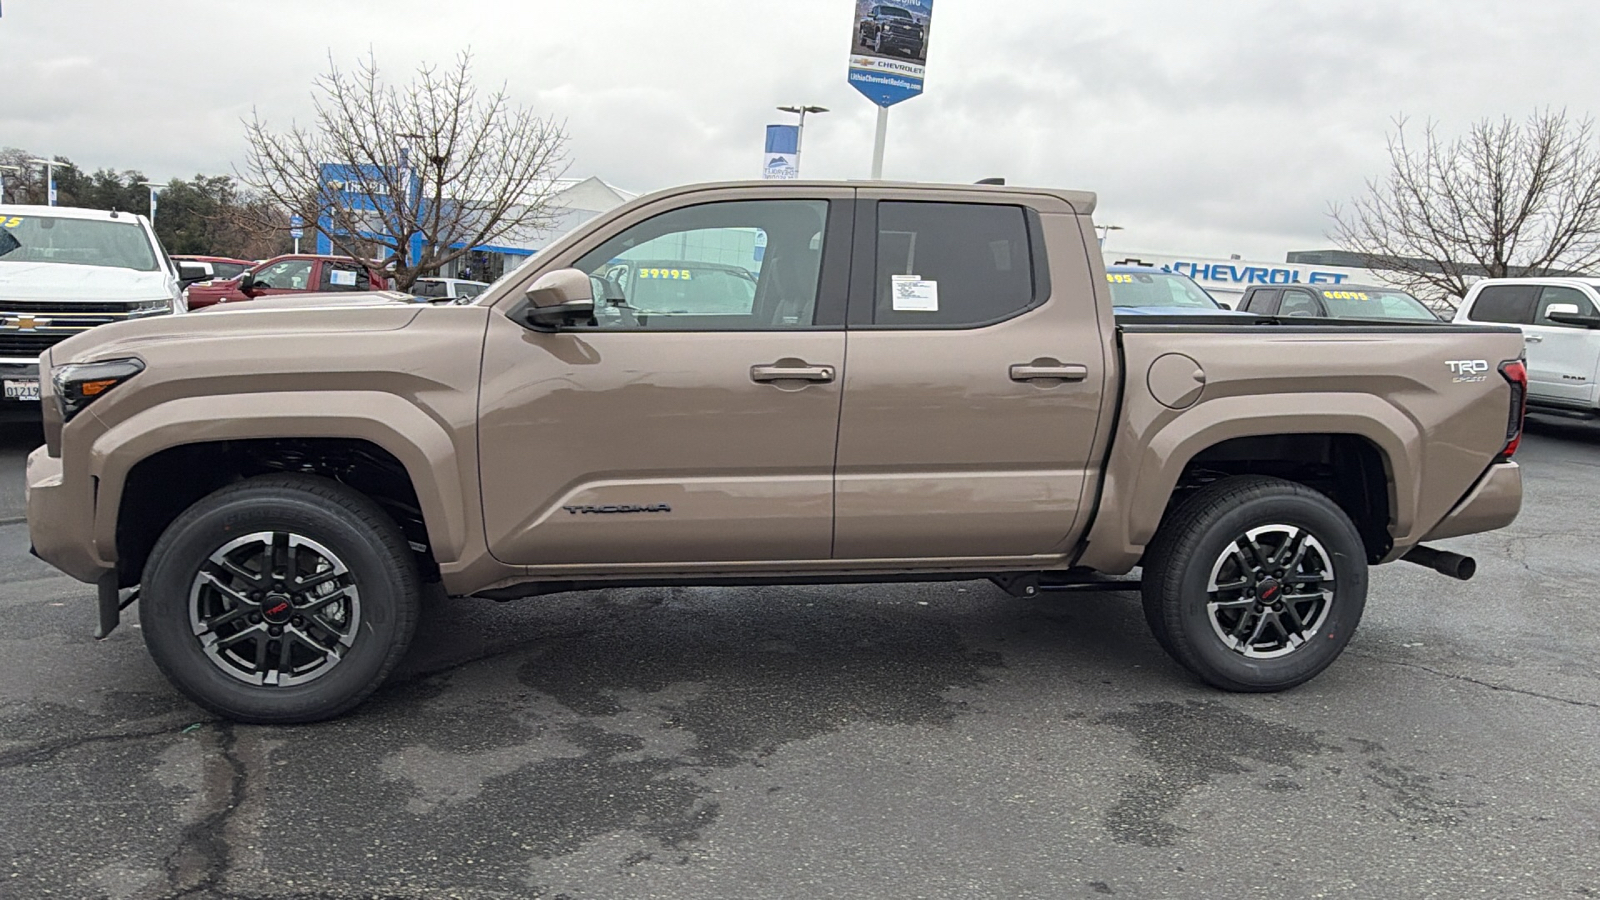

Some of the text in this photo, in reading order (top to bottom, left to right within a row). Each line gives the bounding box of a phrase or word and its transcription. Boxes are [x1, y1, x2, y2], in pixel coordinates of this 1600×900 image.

[877, 61, 922, 74] CHEVROLET
[639, 268, 691, 281] 39995
[1173, 262, 1348, 285] CHEVROLET
[1444, 359, 1489, 375] TRD
[563, 503, 672, 514] TACOMA
[265, 602, 288, 615] TRD
